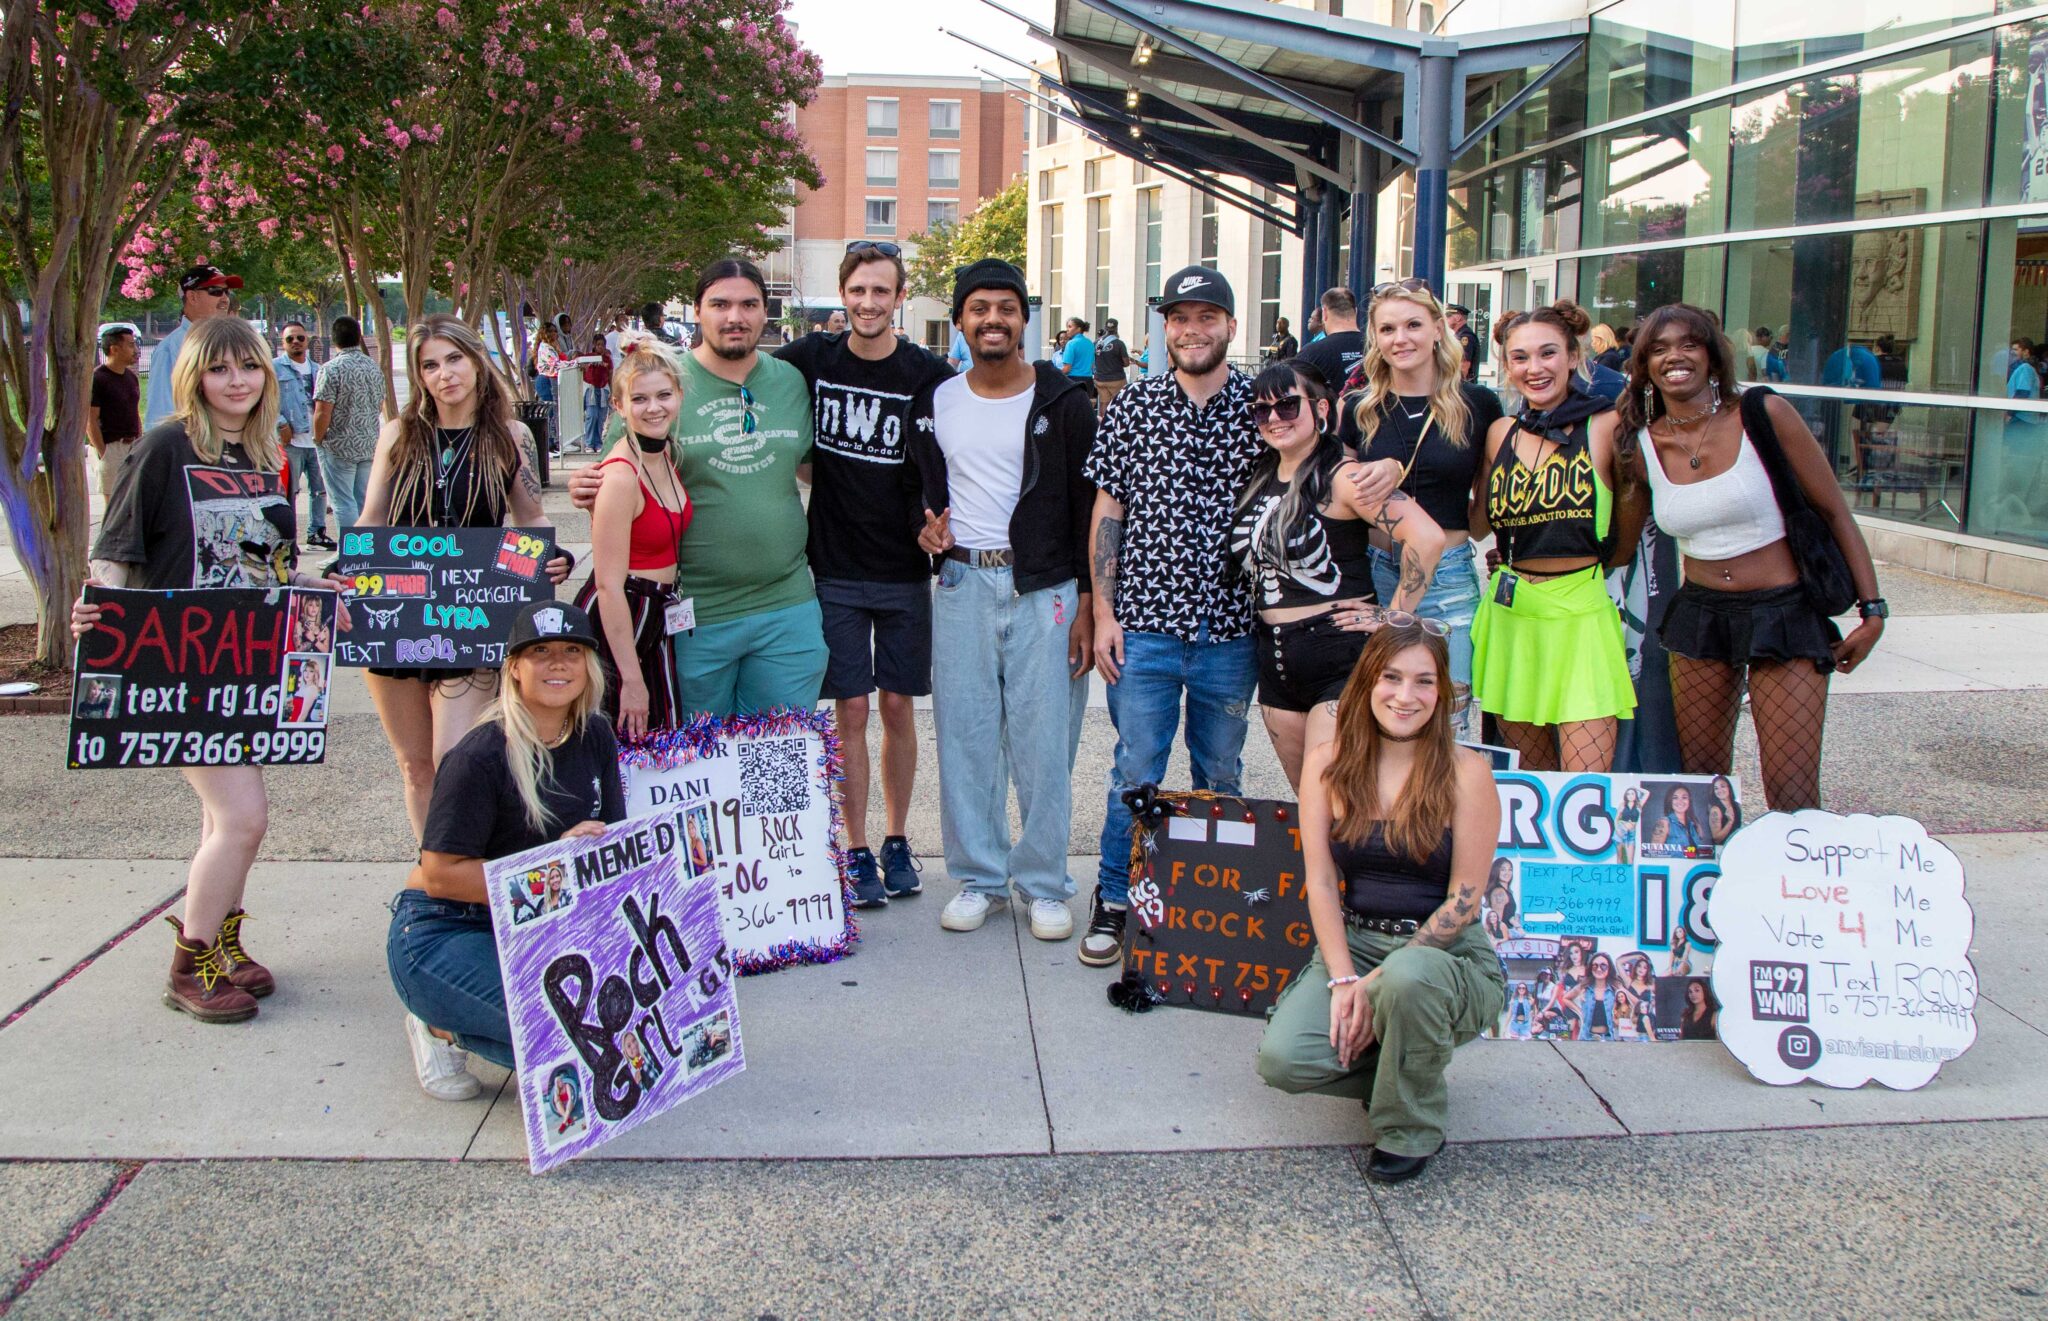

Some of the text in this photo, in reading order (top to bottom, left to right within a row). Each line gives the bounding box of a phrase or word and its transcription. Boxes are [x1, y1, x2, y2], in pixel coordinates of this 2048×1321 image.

[1182, 276, 1203, 287] NIKE
[822, 393, 900, 447] nWo
[680, 434, 712, 445] TEAM
[867, 445, 900, 455] Order
[1528, 512, 1554, 524] ABOUT
[1567, 509, 1593, 519] ROCK
[343, 533, 463, 557] BE COOL
[980, 549, 1007, 568] MK
[441, 569, 483, 586] NEXT
[455, 585, 531, 604] ROCKGIRL
[423, 603, 490, 630] LYRA
[86, 602, 284, 676] SARAH
[336, 634, 509, 664] TEXT RG14 to 757
[128, 682, 187, 715] text
[77, 732, 106, 764] to
[649, 778, 711, 806] DANI
[1497, 776, 1617, 857] RG
[760, 814, 803, 847] ROCK
[1785, 828, 1936, 876] Support Me
[787, 865, 802, 877] to
[1170, 861, 1241, 892] FOR
[1525, 866, 1558, 877] TEXT
[1561, 883, 1576, 894] to
[1780, 874, 1931, 911] Love Me
[1167, 906, 1266, 940] ROCK
[1567, 912, 1622, 923] Suvanna
[1761, 911, 1933, 949] Vote 4 Me
[1132, 949, 1294, 993] TEXT 757
[1819, 960, 1976, 1011] Text RG03
[1755, 990, 1807, 1017] WNOR
[1817, 993, 1839, 1014] To
